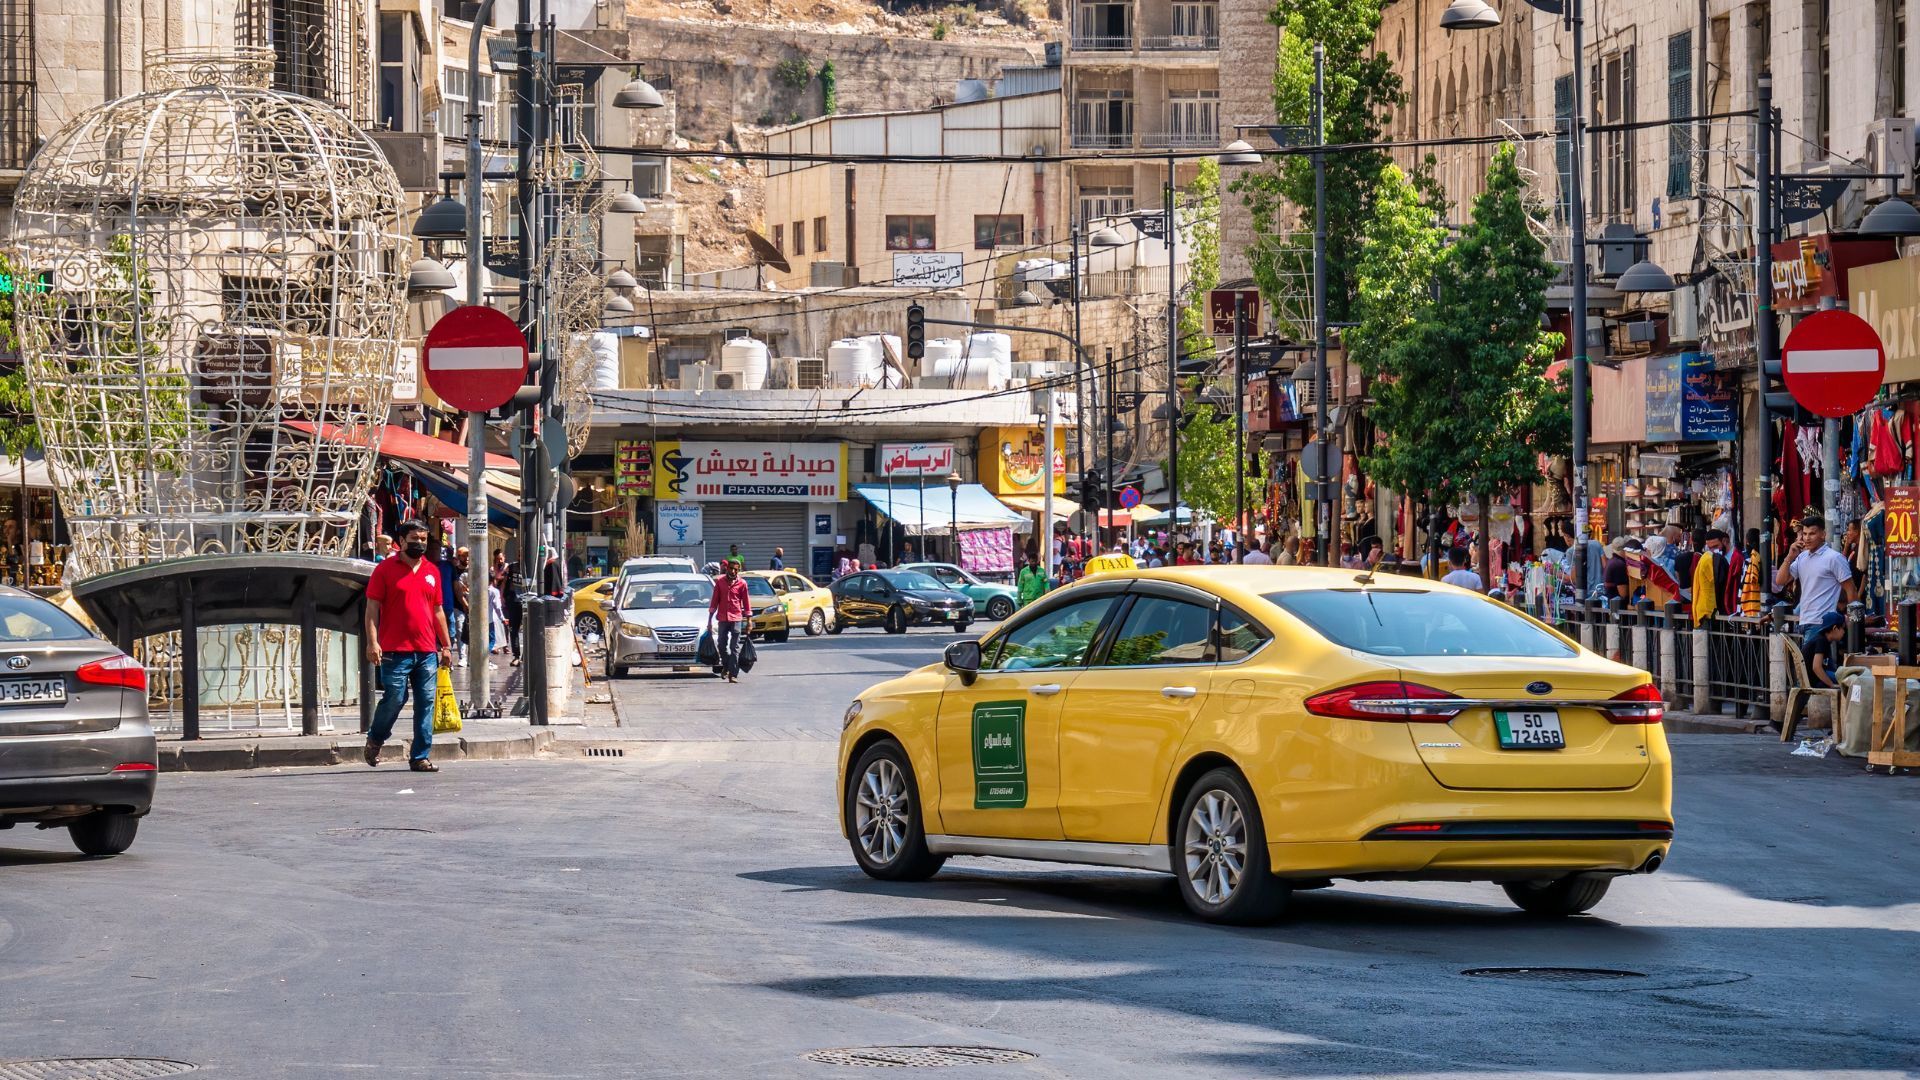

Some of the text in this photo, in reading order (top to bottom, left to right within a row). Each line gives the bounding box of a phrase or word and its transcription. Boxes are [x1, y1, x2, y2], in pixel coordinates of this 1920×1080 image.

[1858, 289, 1920, 361] Max
[696, 449, 835, 477] صيدلية يعيش
[884, 448, 951, 473] الرياض
[728, 485, 804, 495] PHARMACY
[1098, 558, 1129, 570] TAXI
[1523, 714, 1543, 728] 50
[1511, 730, 1561, 744] 72468
